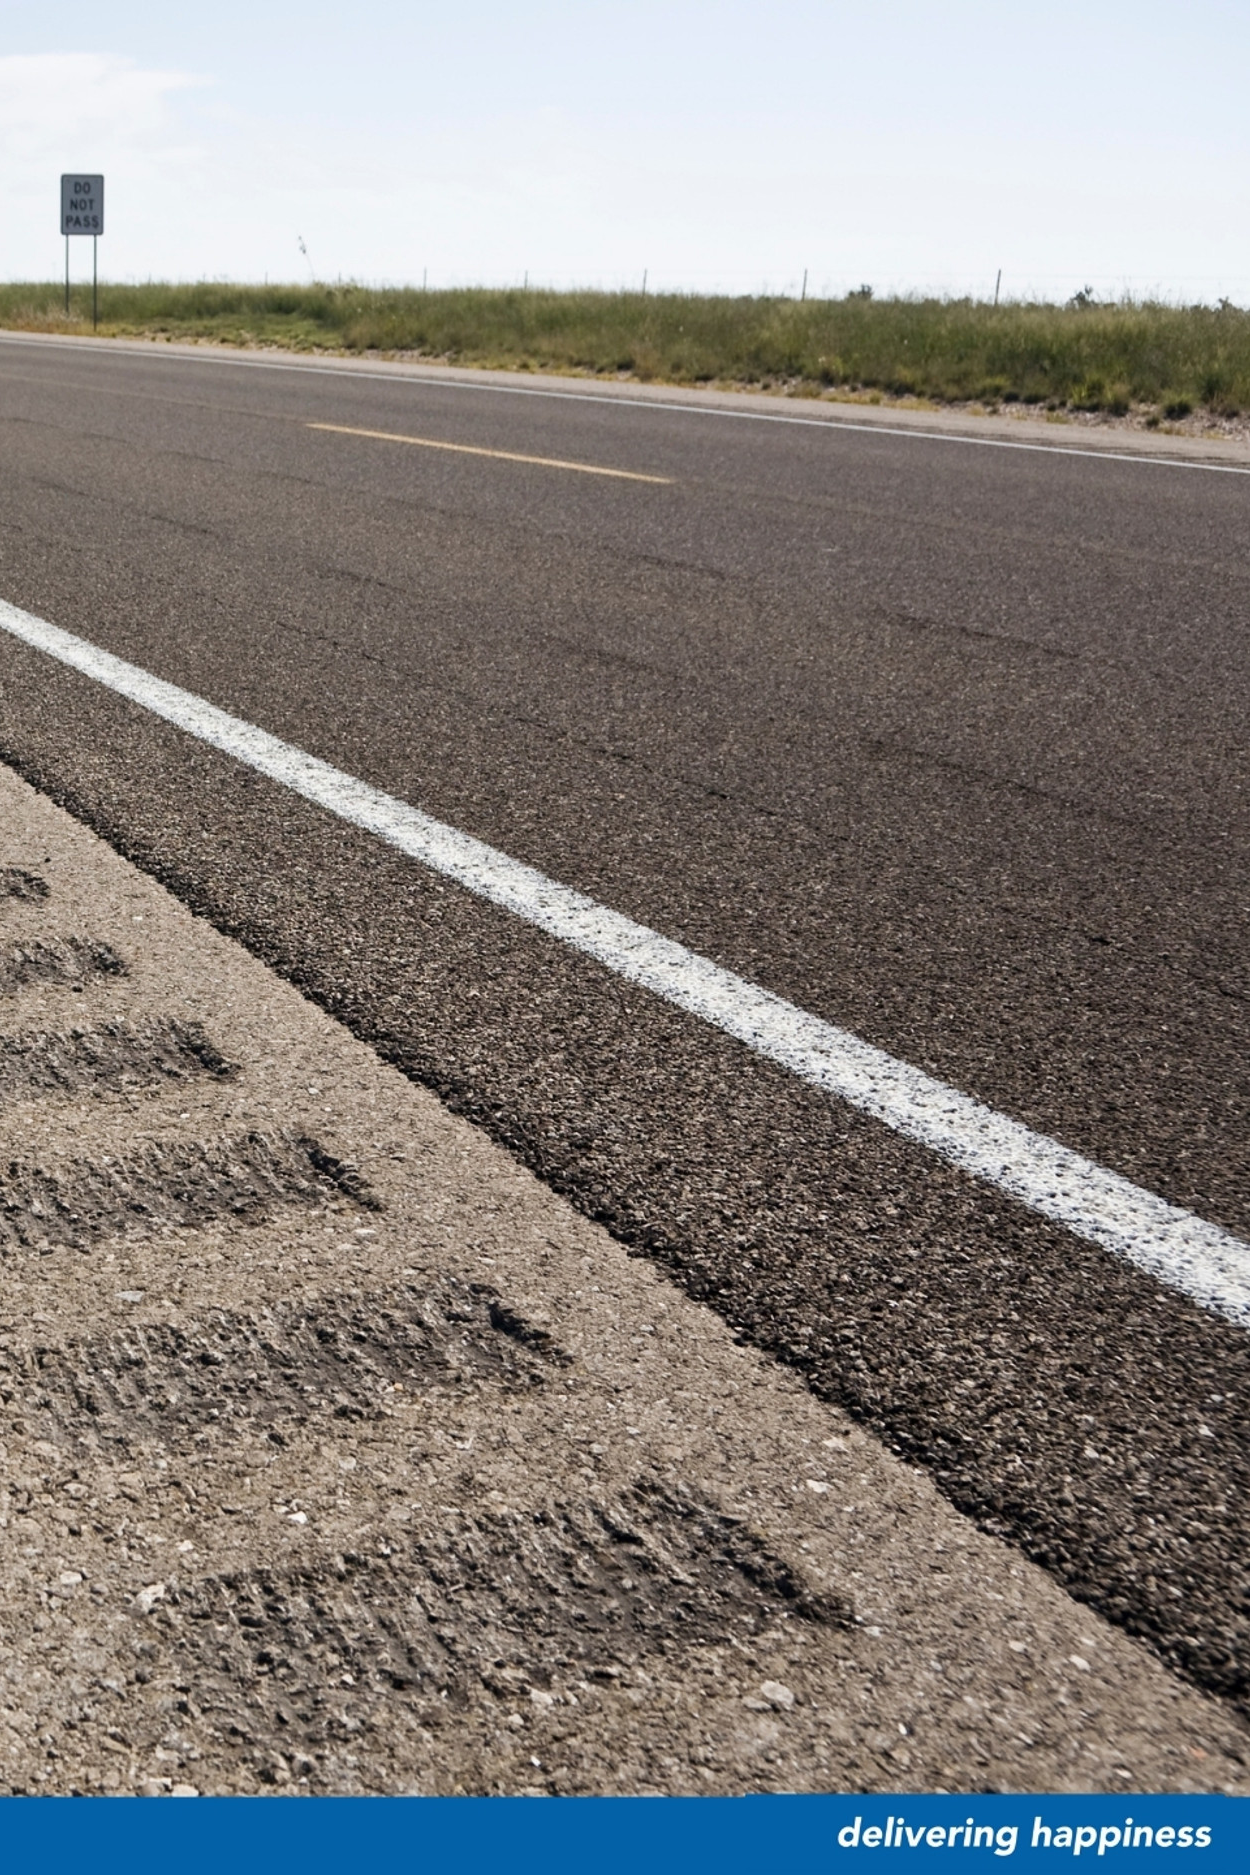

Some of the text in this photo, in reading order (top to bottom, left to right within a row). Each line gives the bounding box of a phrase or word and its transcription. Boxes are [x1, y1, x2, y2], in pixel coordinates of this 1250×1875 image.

[74, 181, 91, 195] DO
[70, 198, 95, 211] NOT
[65, 215, 100, 229] PASS
